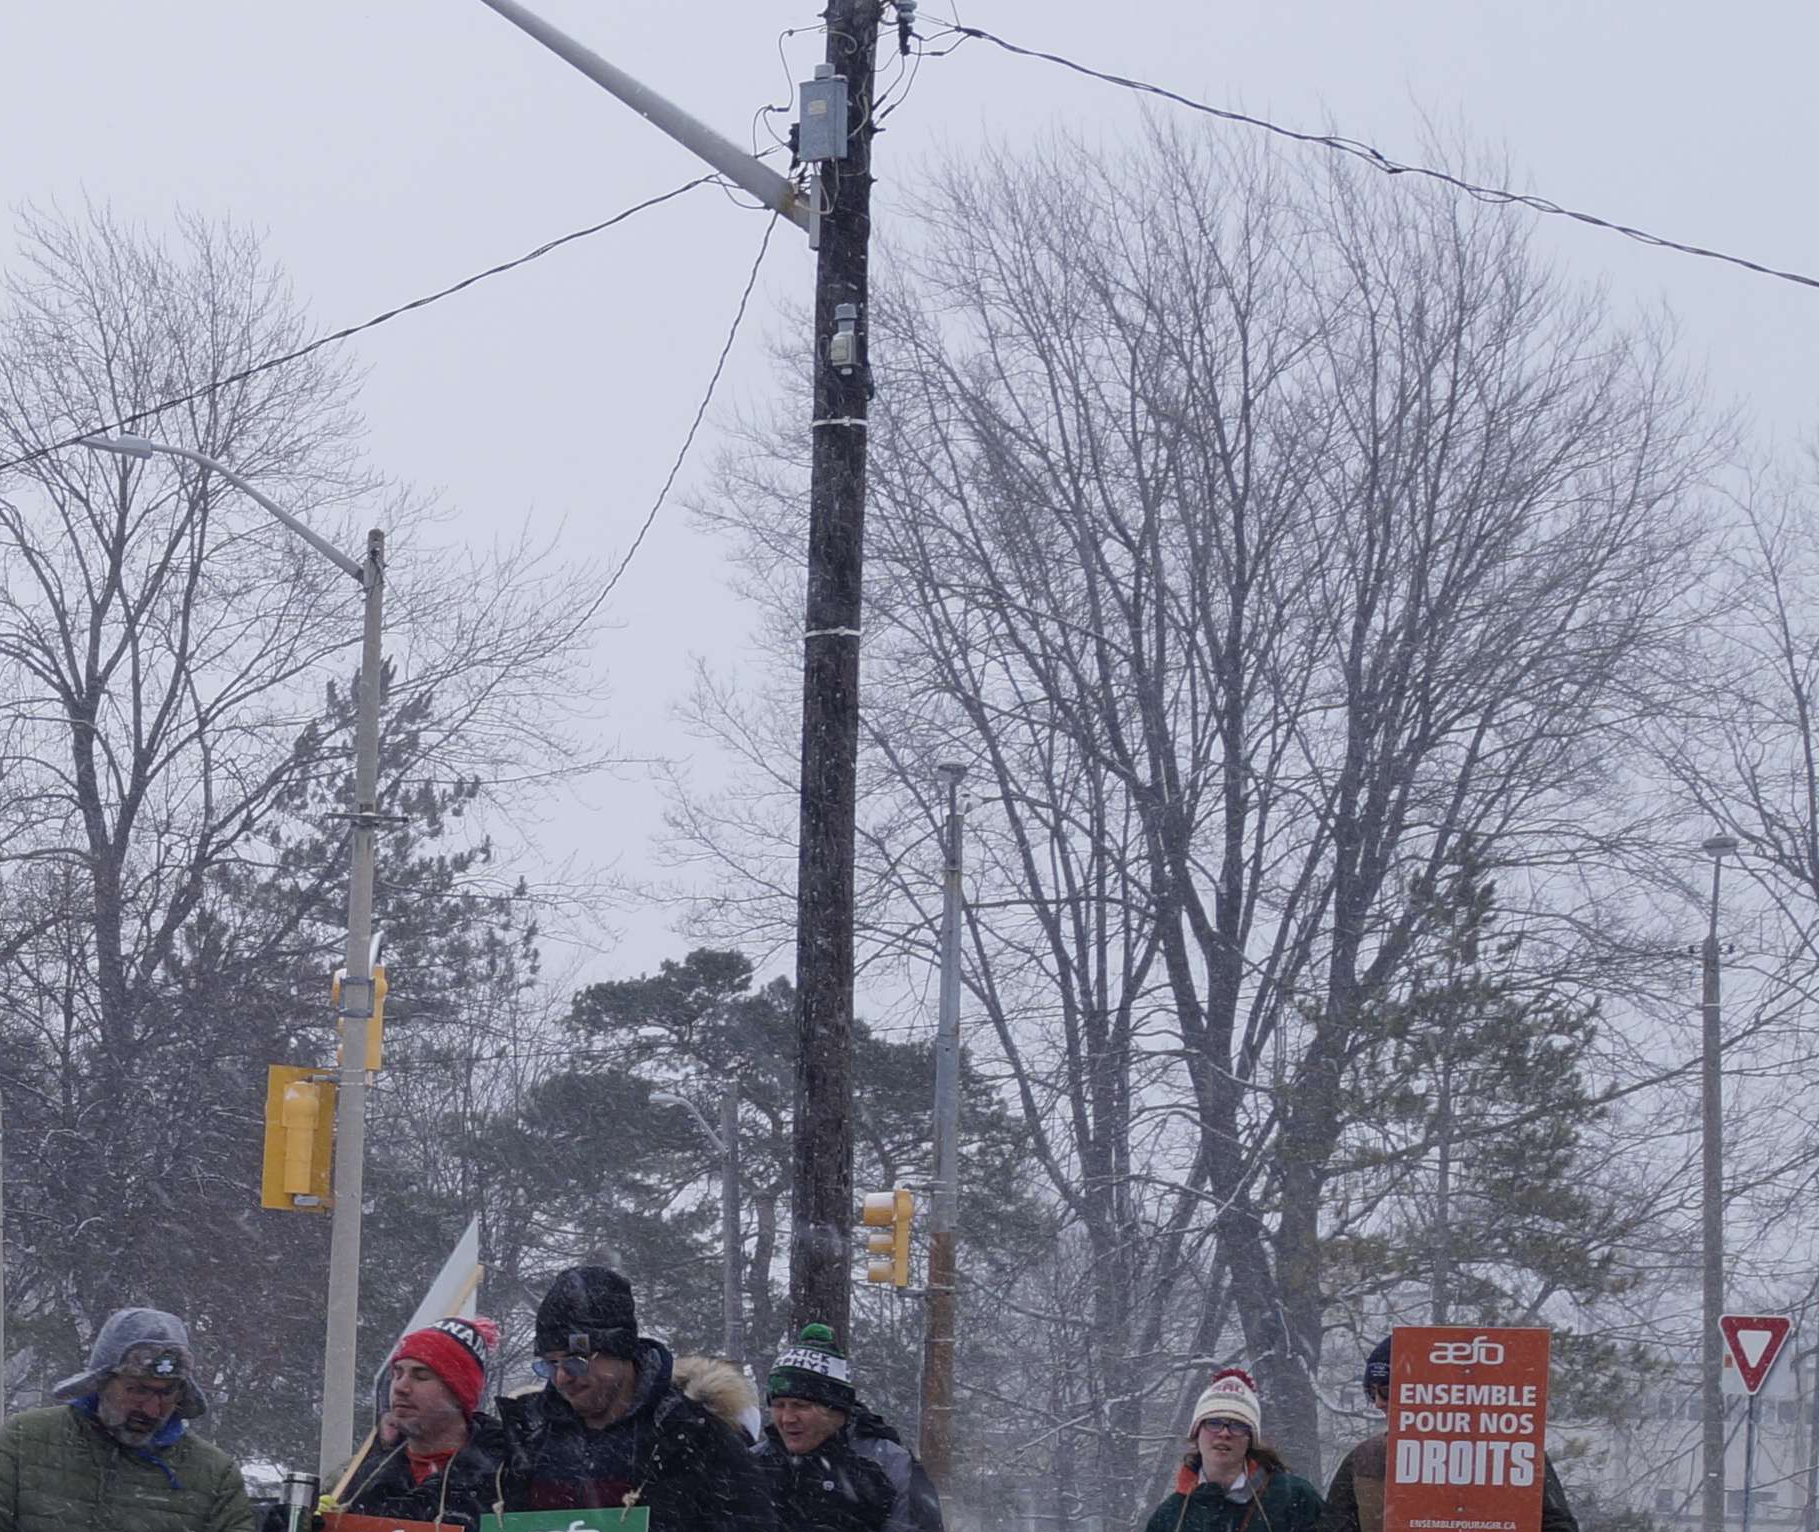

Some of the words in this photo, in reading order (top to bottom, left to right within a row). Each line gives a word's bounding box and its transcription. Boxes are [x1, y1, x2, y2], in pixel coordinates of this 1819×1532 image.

[1399, 1383, 1537, 1407] ENSEMBLE
[1399, 1411, 1471, 1433] POUR
[1479, 1412, 1534, 1435] NOS
[1395, 1439, 1535, 1487] DROITS
